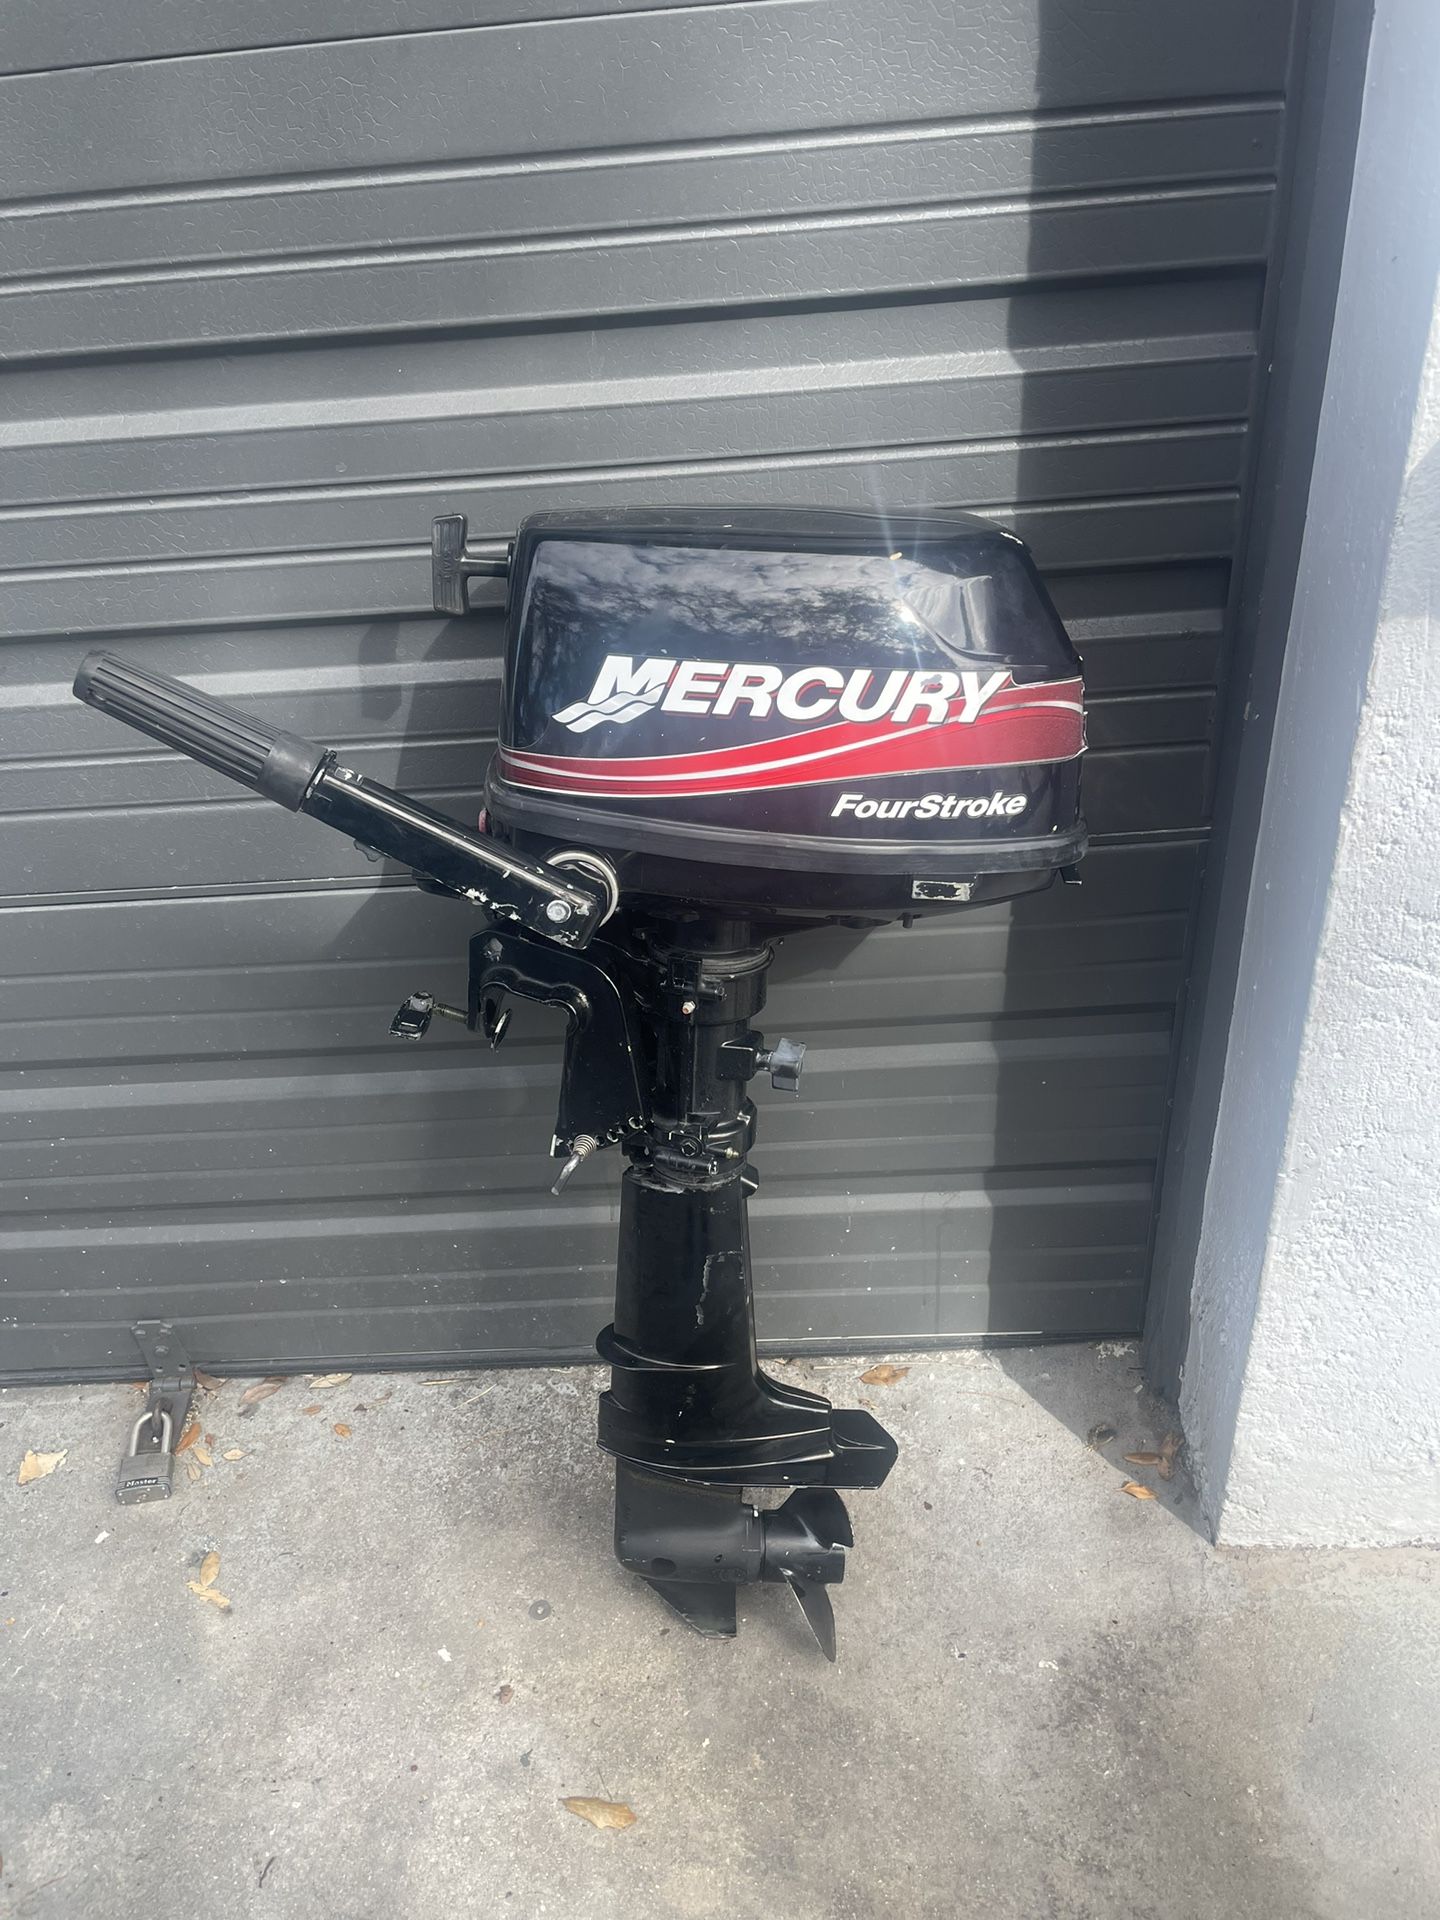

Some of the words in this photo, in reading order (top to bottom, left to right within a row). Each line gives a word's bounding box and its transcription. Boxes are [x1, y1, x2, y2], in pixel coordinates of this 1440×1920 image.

[586, 655, 1012, 724] MERCURY
[830, 792, 1028, 819] FourStroke
[126, 1479, 157, 1487] Master
